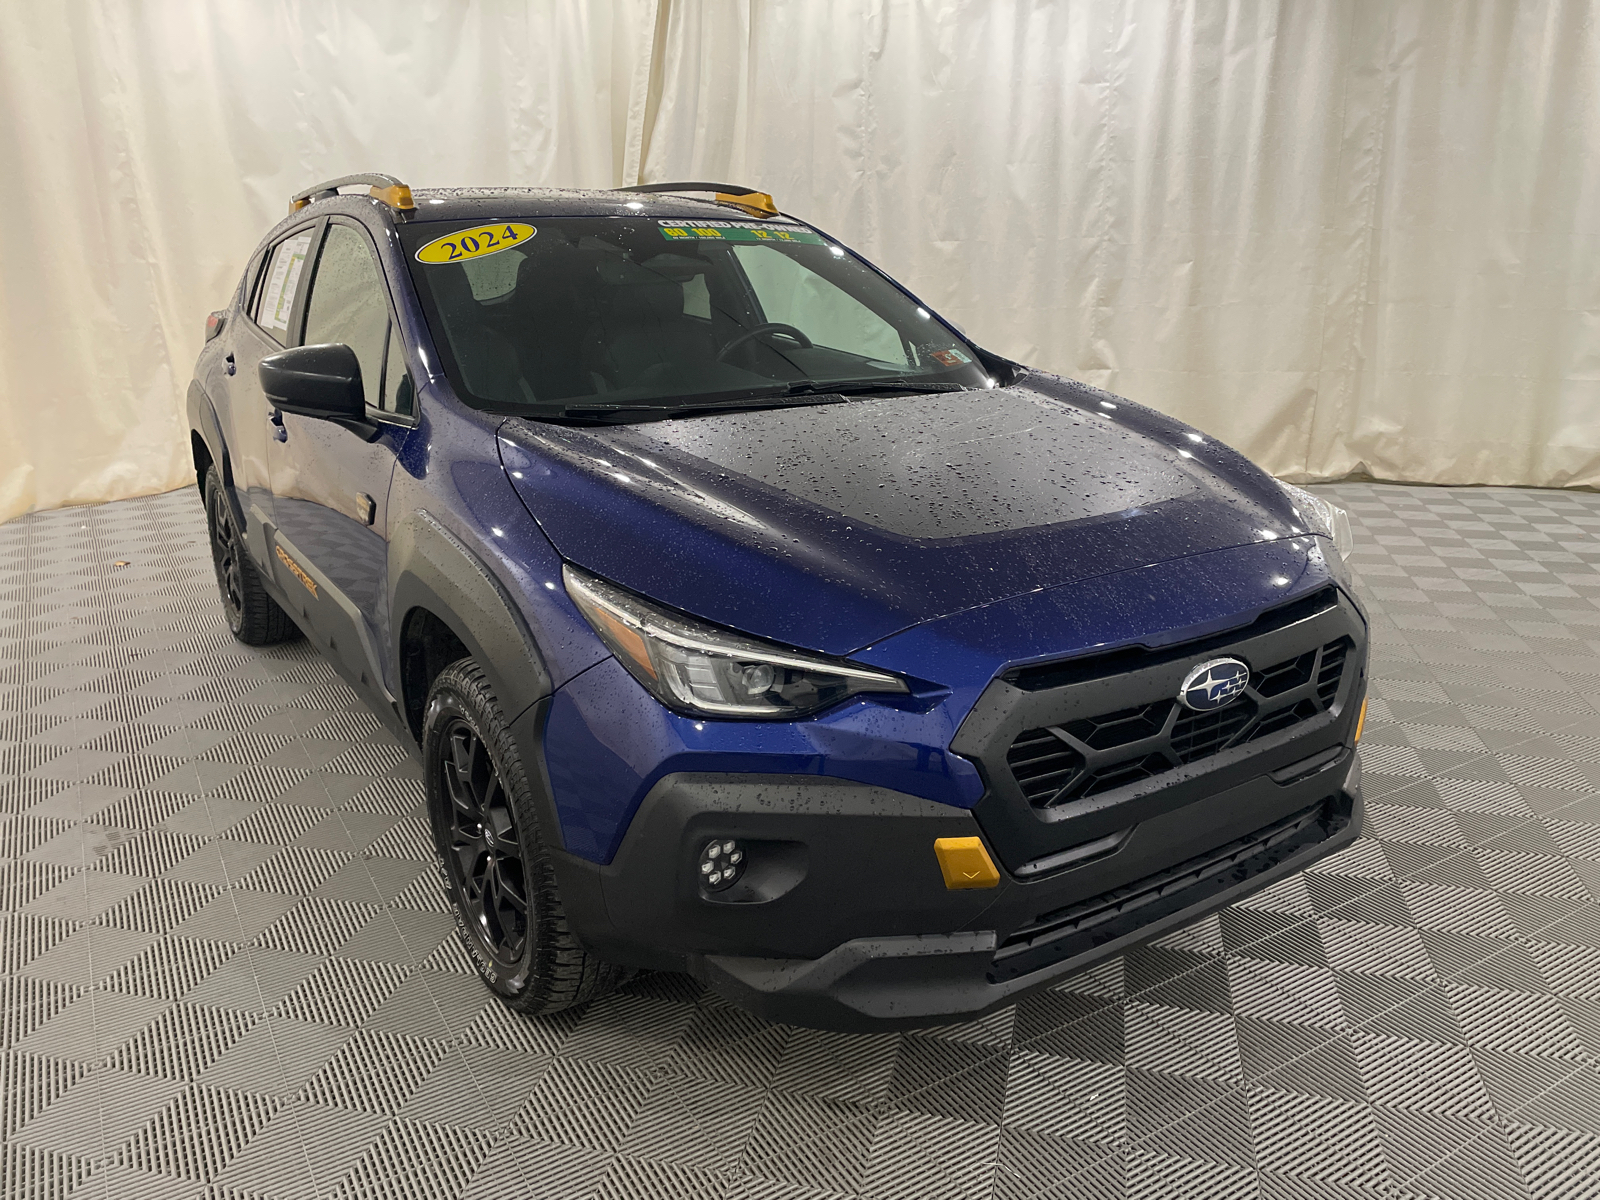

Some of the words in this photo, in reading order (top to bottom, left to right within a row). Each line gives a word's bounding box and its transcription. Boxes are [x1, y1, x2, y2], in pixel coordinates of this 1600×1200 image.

[657, 220, 731, 228] CERTIFIED
[691, 228, 722, 237] 100
[750, 230, 773, 239] 12
[773, 231, 795, 240] 12
[441, 225, 518, 260] 2024
